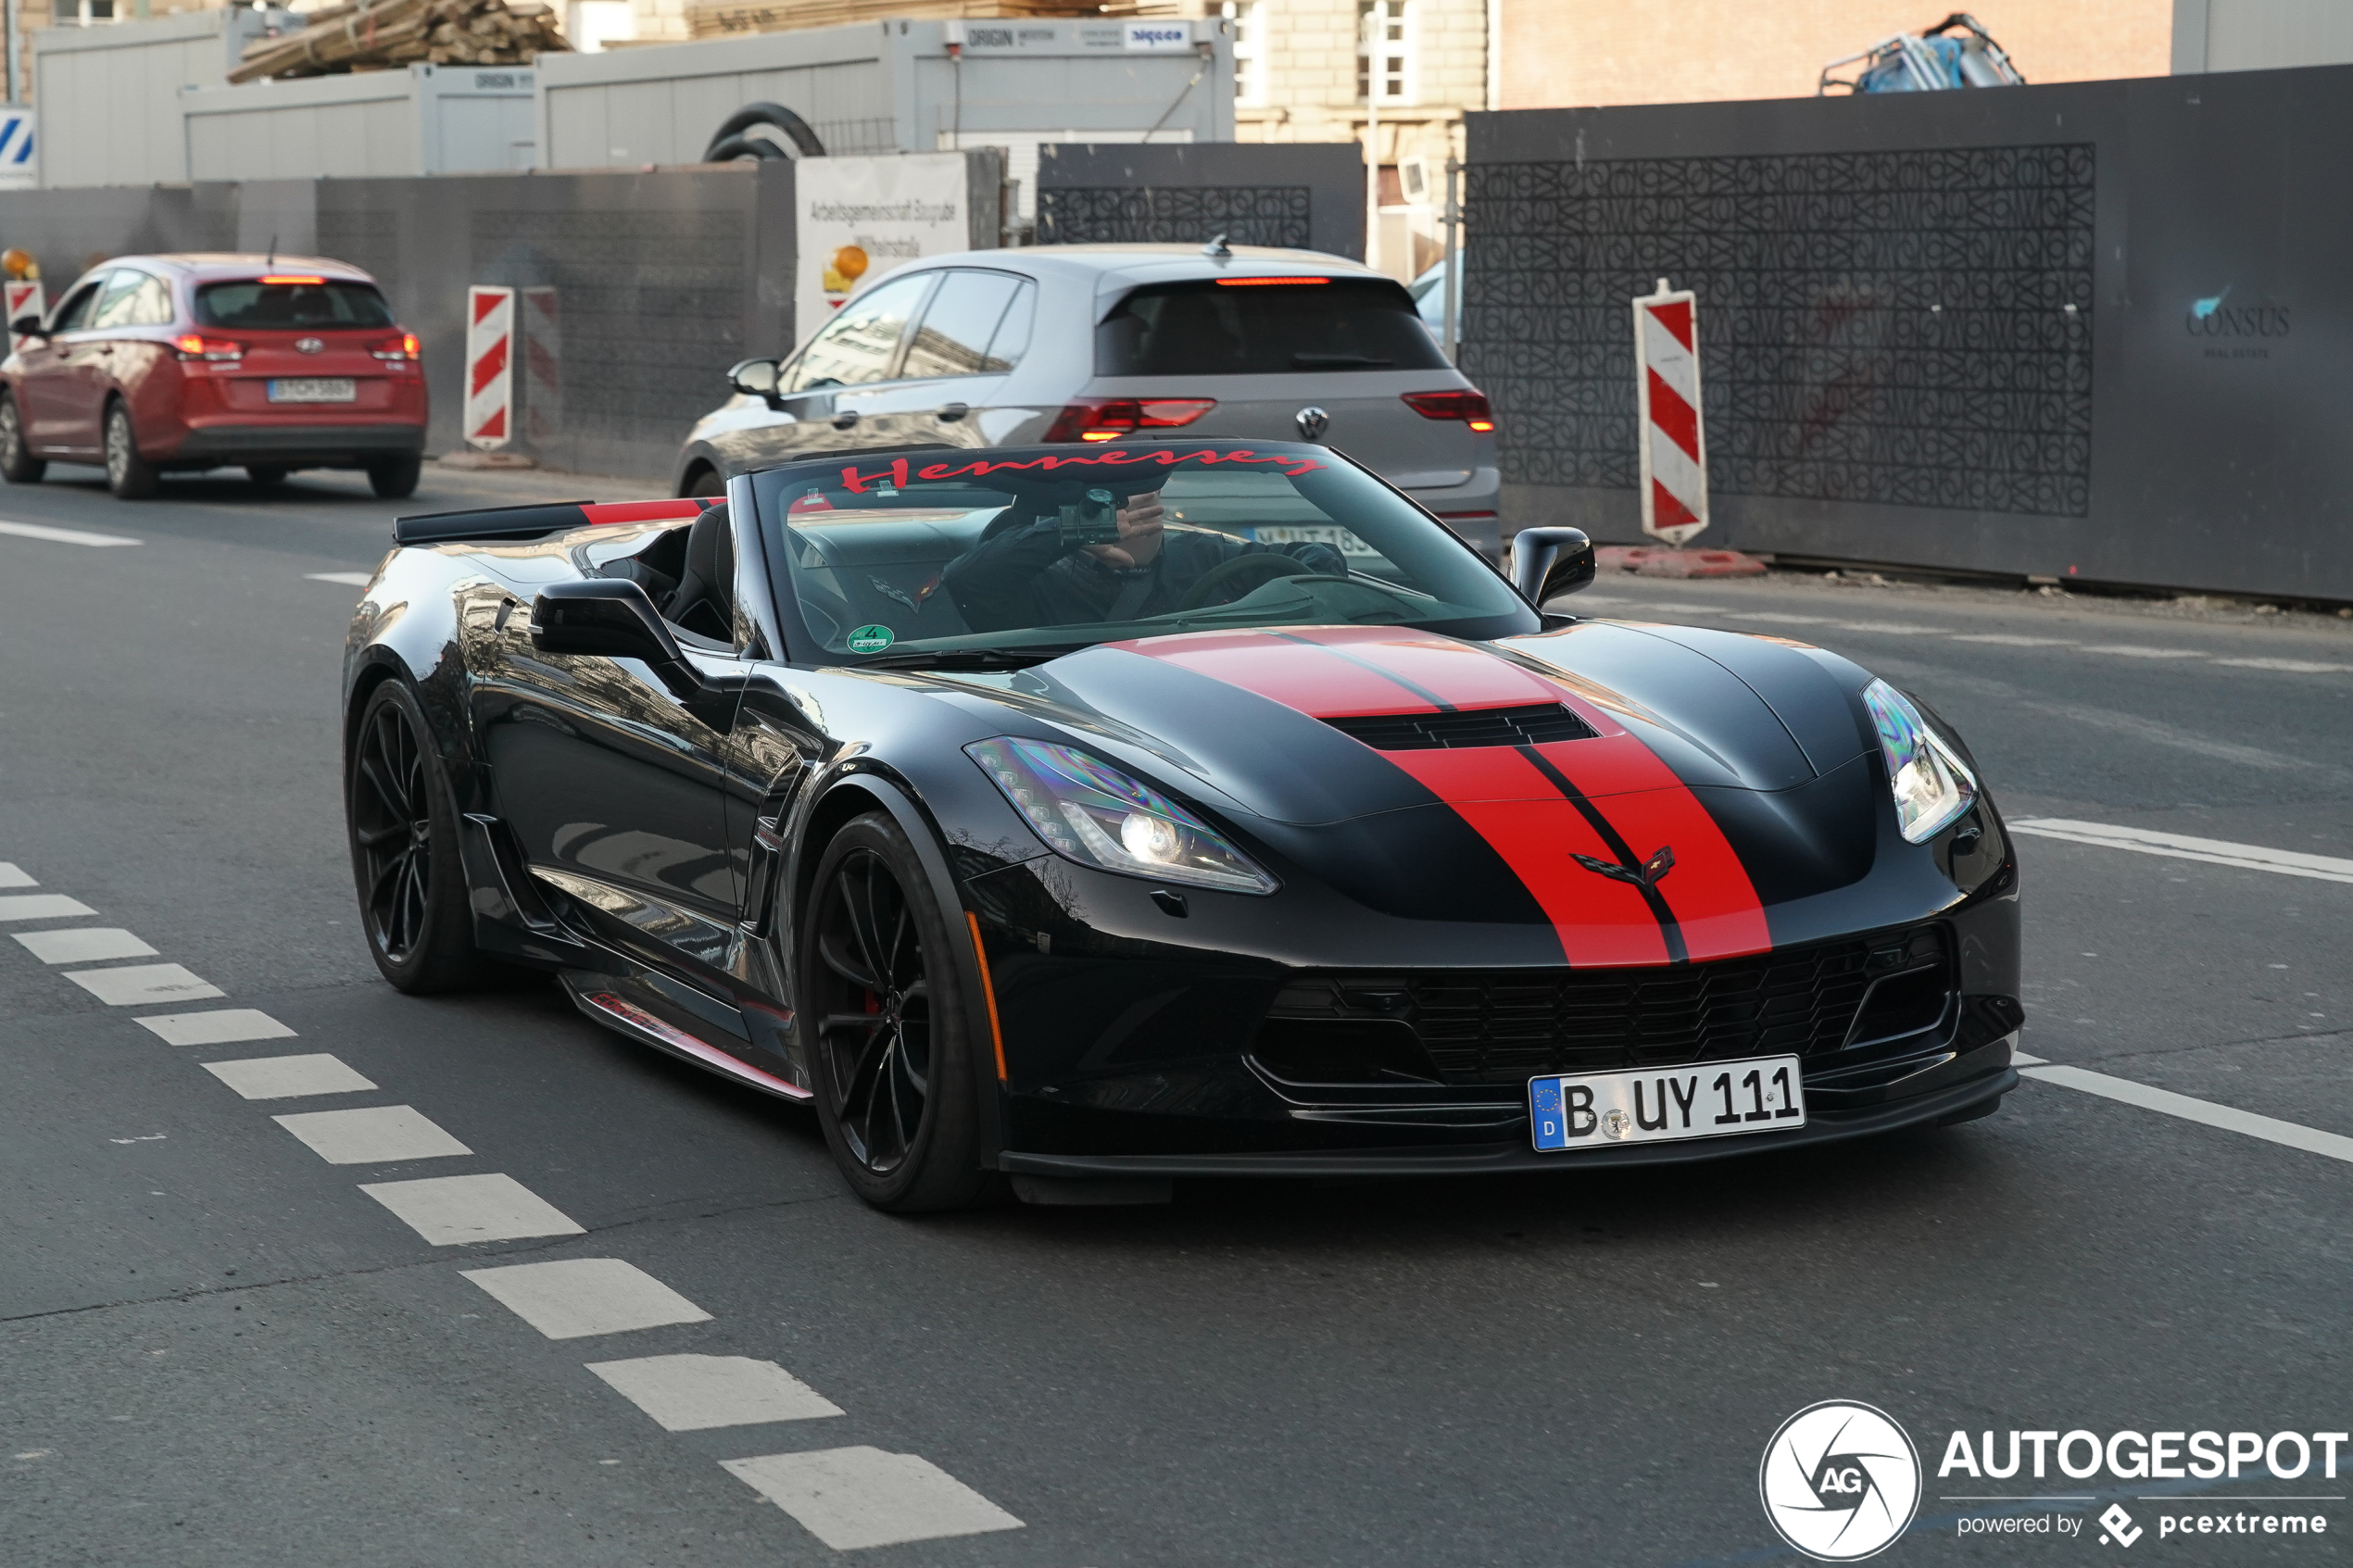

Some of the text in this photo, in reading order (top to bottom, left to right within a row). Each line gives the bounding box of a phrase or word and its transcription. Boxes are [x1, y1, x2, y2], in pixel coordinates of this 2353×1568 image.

[968, 28, 1013, 47] ORIGIN
[2186, 306, 2289, 338] CONSUS
[841, 449, 1328, 494] Hennessey
[865, 626, 877, 639] 4
[1543, 1121, 1555, 1137] D
[1564, 1085, 1598, 1138] B
[1633, 1074, 1698, 1132] UY
[1712, 1066, 1800, 1125] 111
